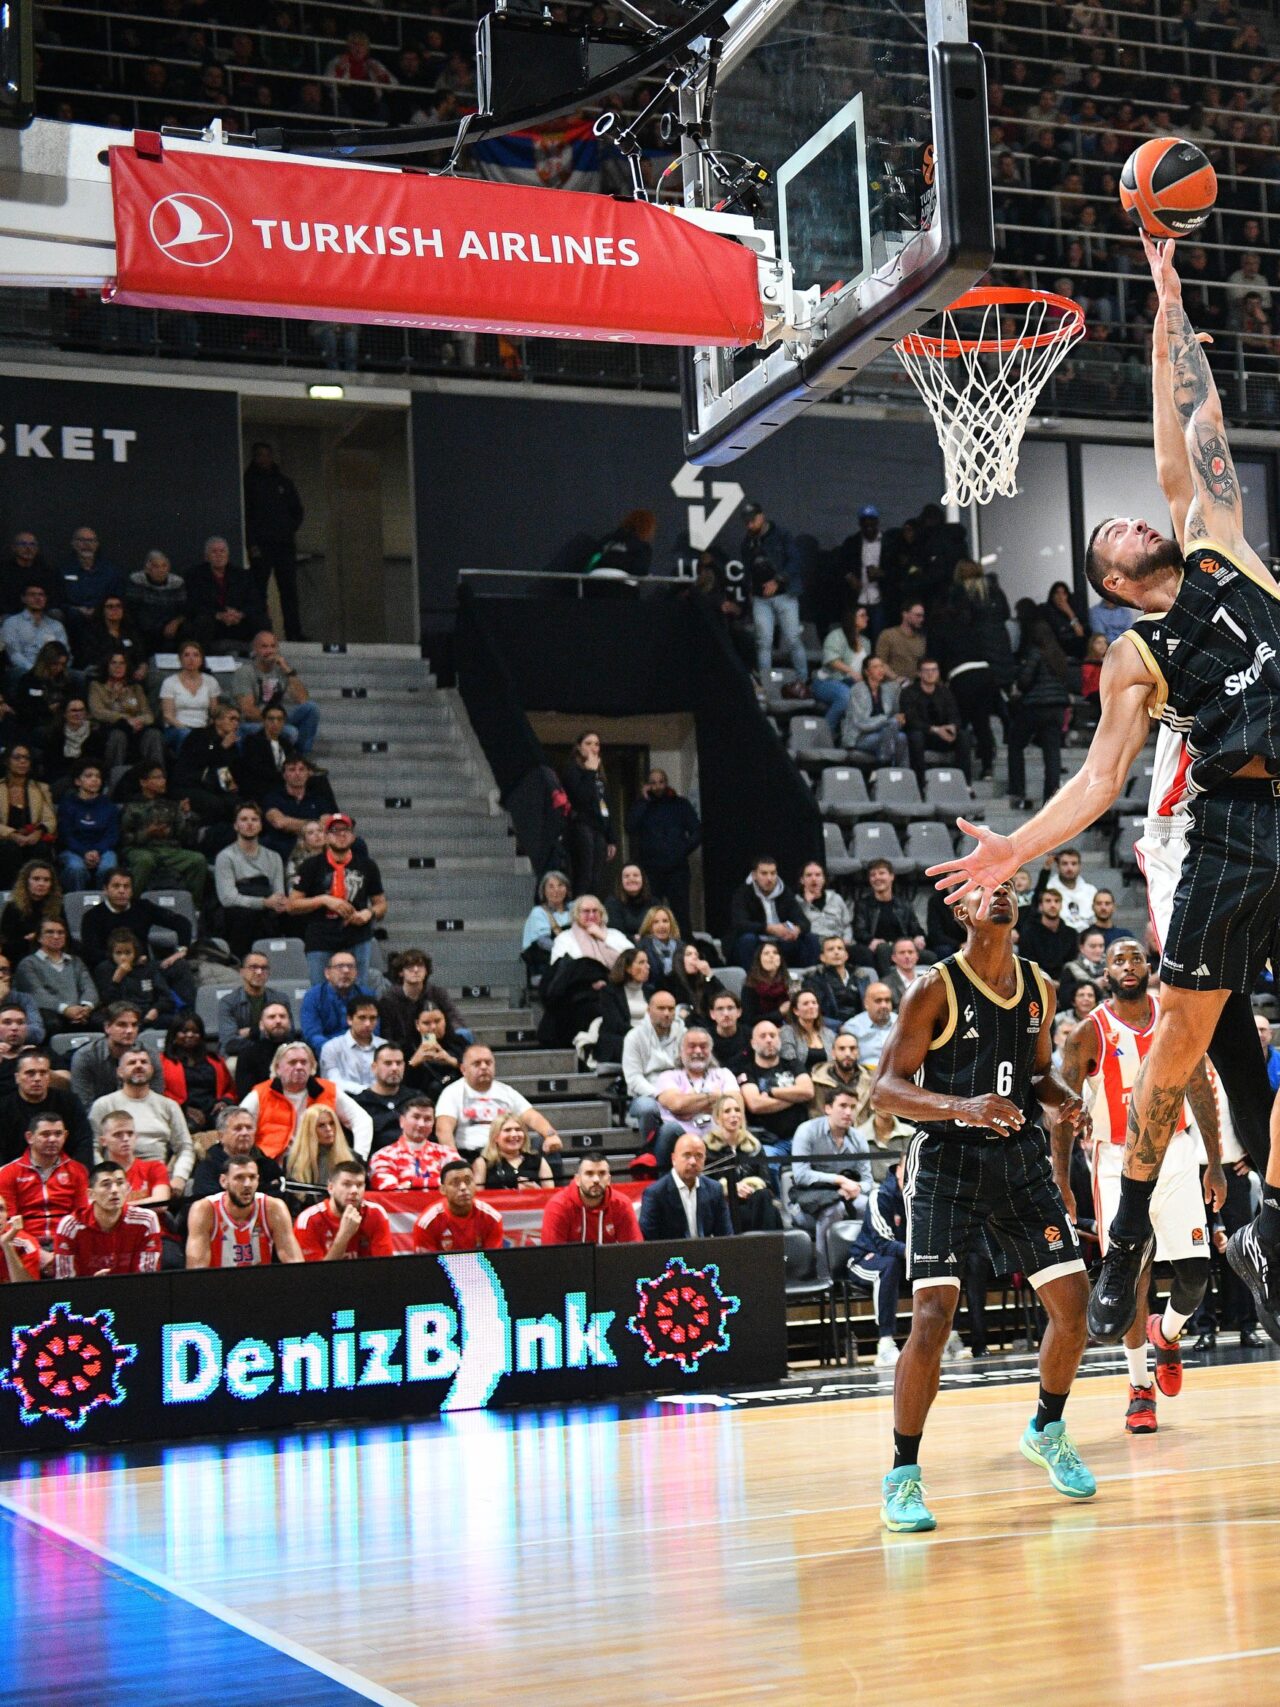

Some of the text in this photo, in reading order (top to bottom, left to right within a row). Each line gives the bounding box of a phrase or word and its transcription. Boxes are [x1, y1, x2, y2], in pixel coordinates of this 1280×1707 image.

[252, 219, 641, 267] TURKISH AIRLINES
[485, 325, 584, 338] TURKISH
[0, 424, 137, 462] KET
[1211, 606, 1248, 642] 7
[996, 1060, 1013, 1097] 6
[162, 1291, 618, 1405] DenizBnk
